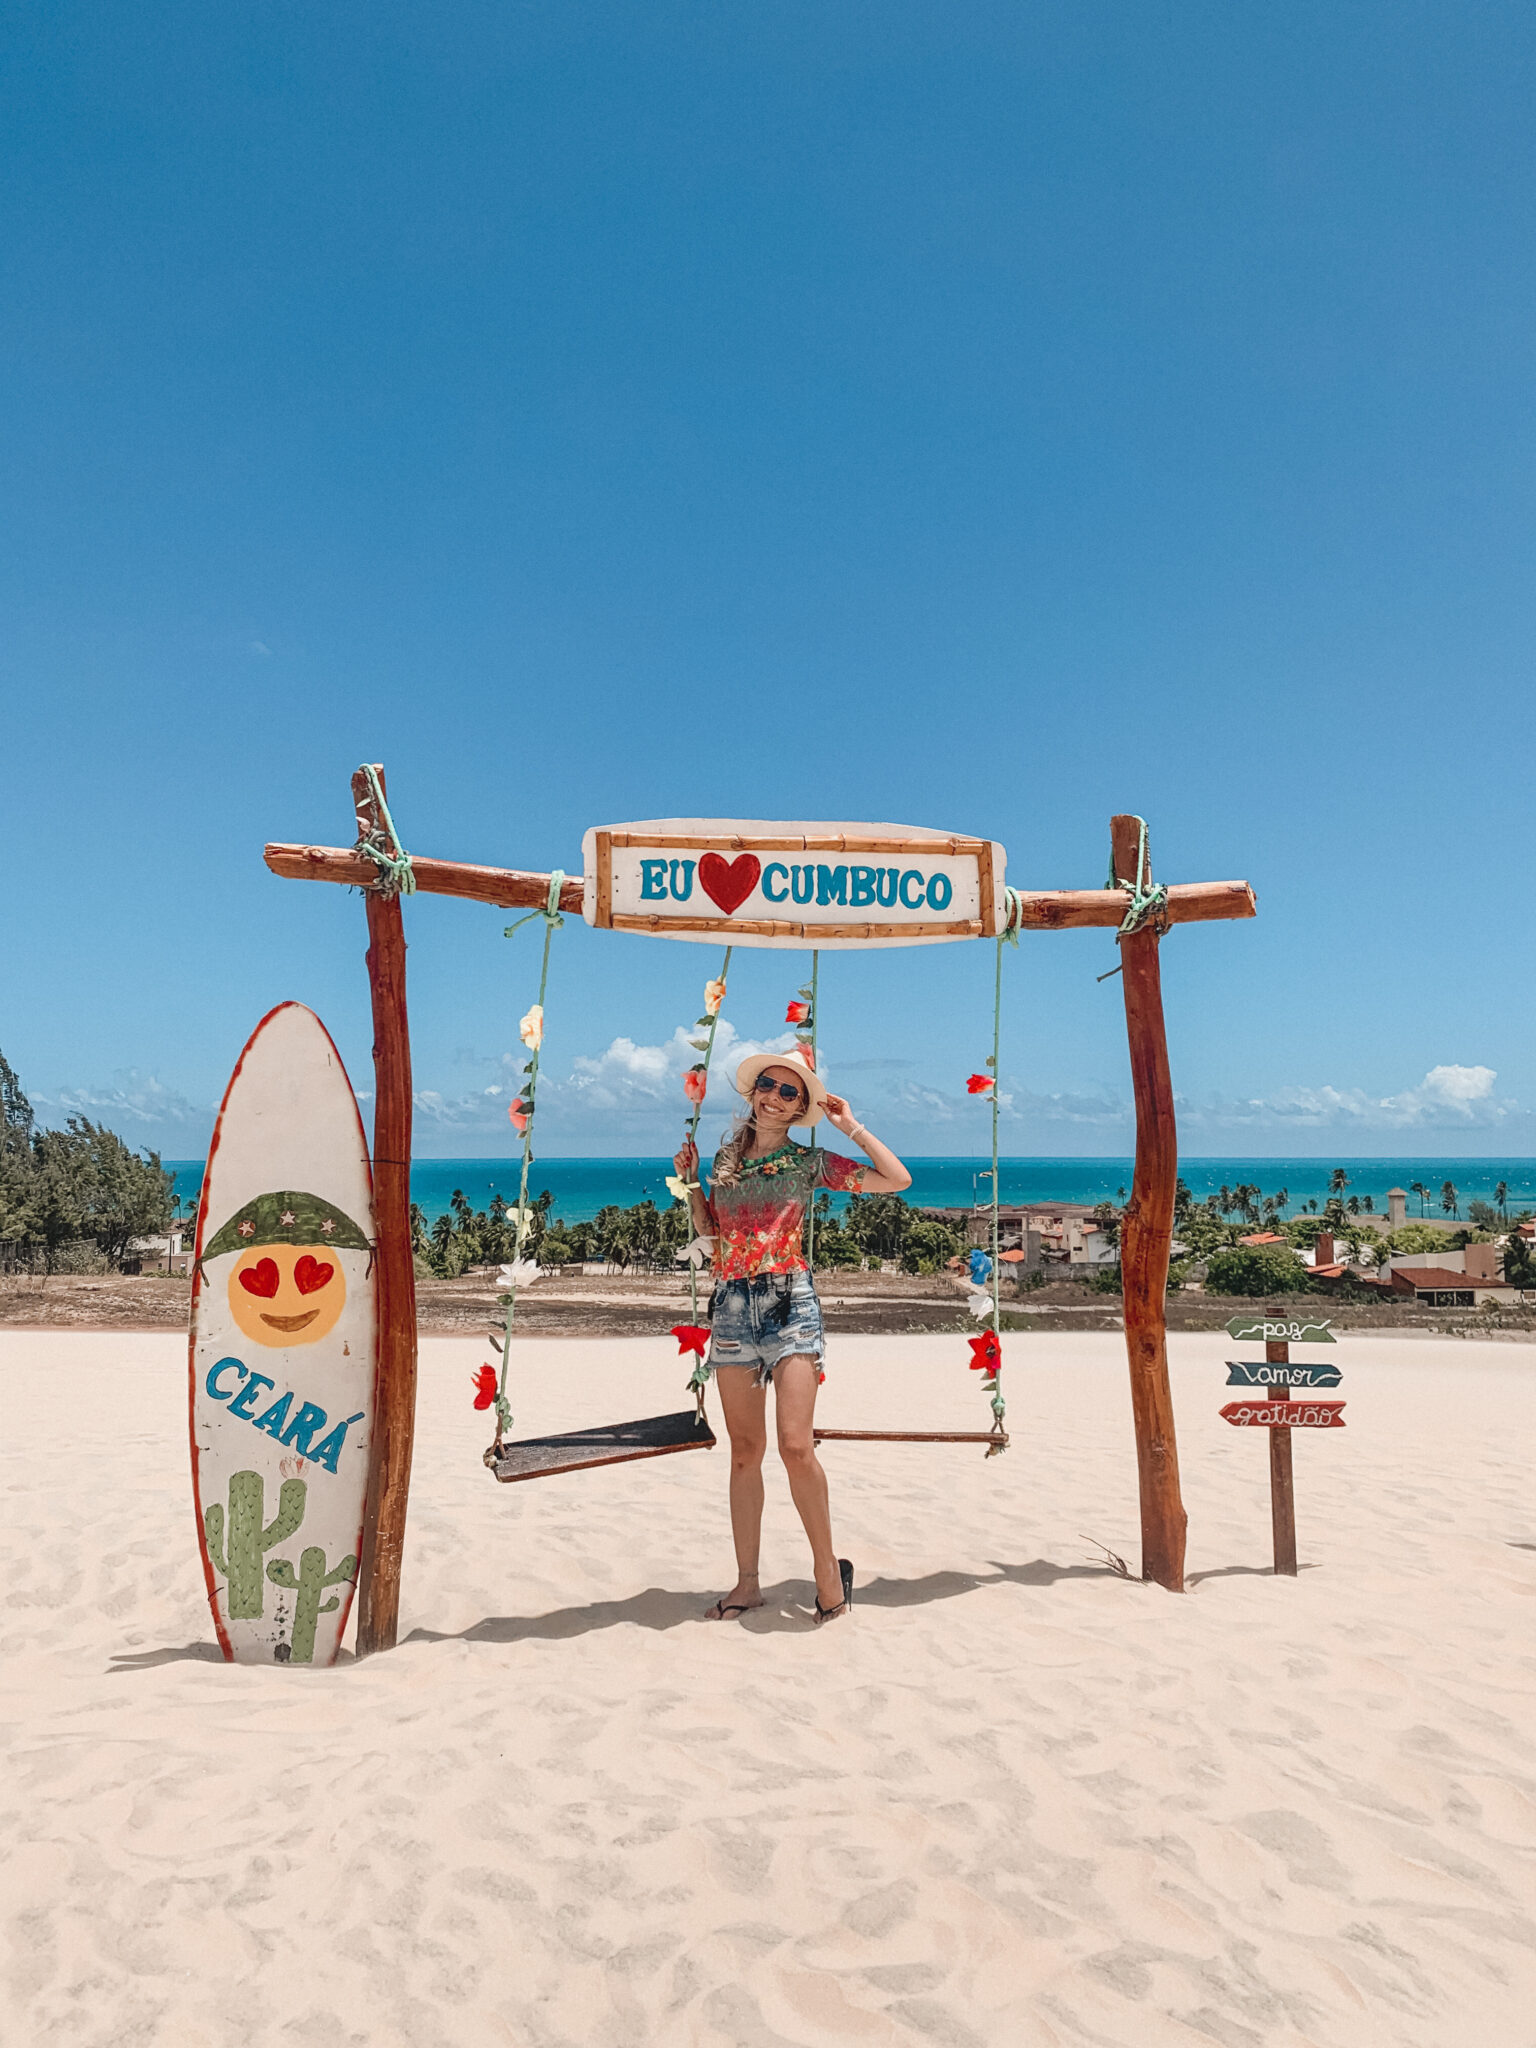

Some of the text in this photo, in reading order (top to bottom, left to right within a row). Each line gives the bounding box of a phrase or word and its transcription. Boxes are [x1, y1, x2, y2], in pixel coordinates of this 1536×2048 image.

[639, 858, 952, 911] EU CUMBUCO
[1262, 1321, 1303, 1341] paz
[1256, 1366, 1315, 1387] amor
[205, 1356, 365, 1475] CEARÁ
[1233, 1404, 1335, 1427] gratidão
